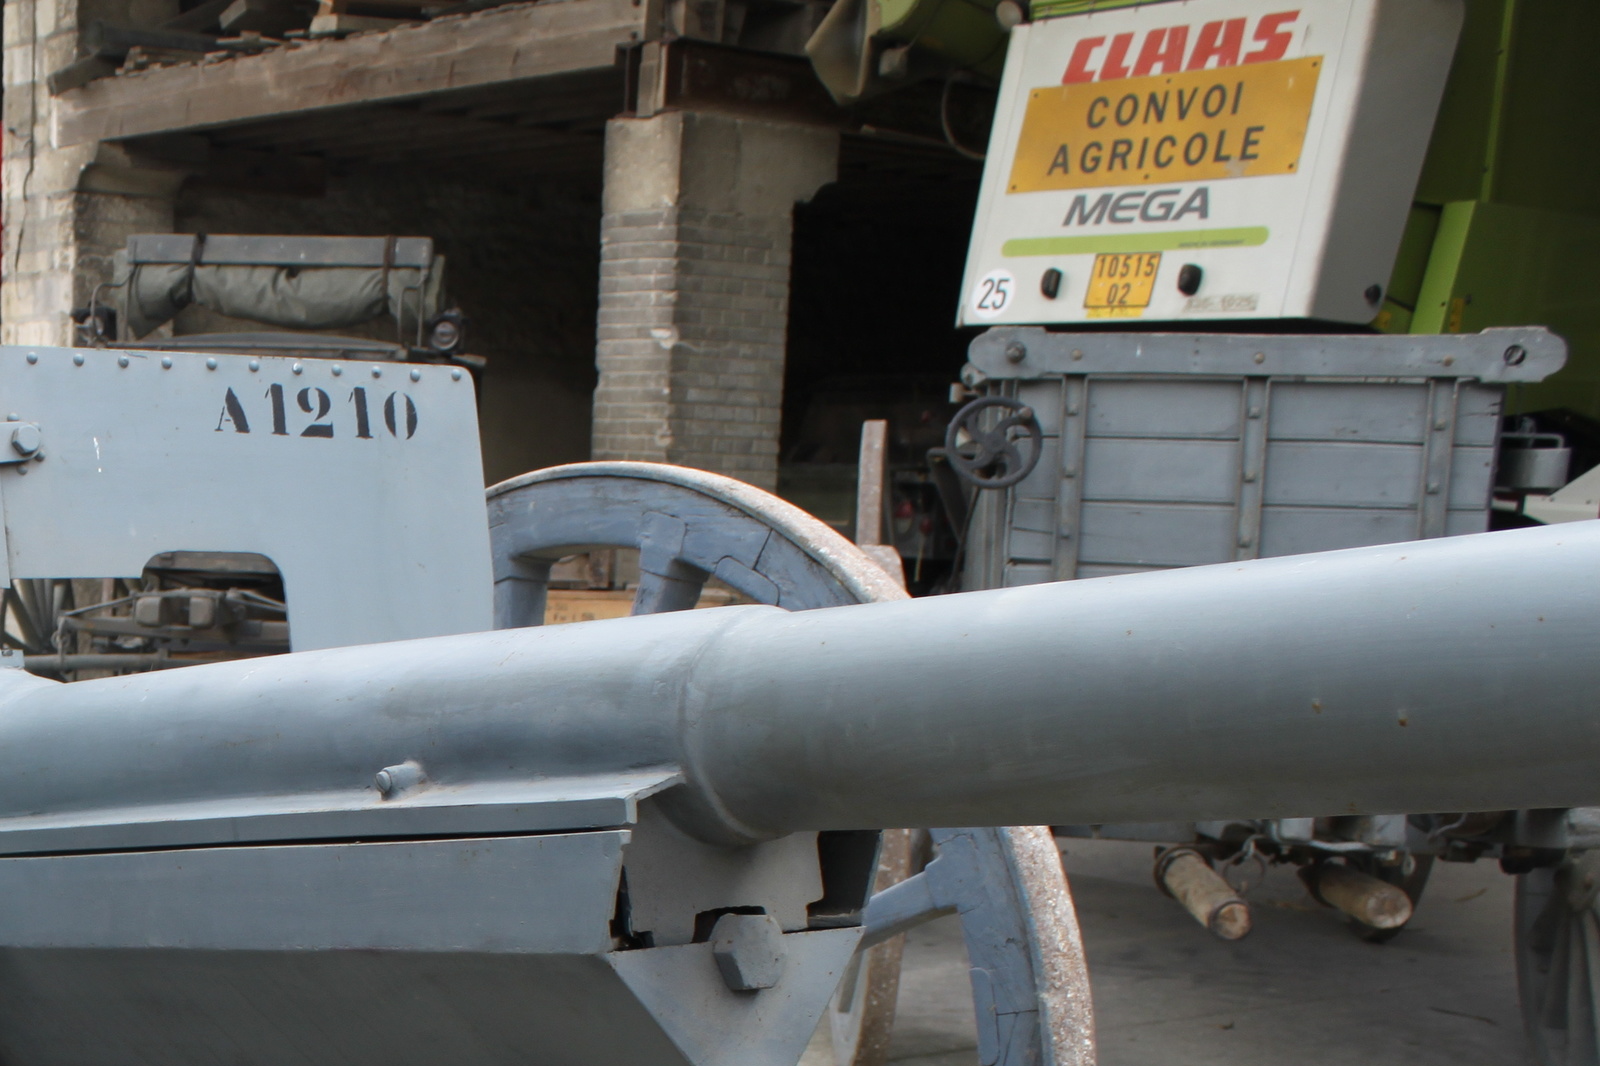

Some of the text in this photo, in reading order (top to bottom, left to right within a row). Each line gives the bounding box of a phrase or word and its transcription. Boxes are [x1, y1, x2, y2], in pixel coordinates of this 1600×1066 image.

[1062, 10, 1301, 85] CLAAS
[1087, 81, 1244, 129] CONVOI
[1047, 125, 1265, 176] AGRICOLE
[1062, 187, 1209, 226] MEGA
[1098, 255, 1157, 278] 10515
[977, 278, 1011, 309] 25
[1106, 283, 1132, 305] 02
[214, 383, 419, 440] A1210
